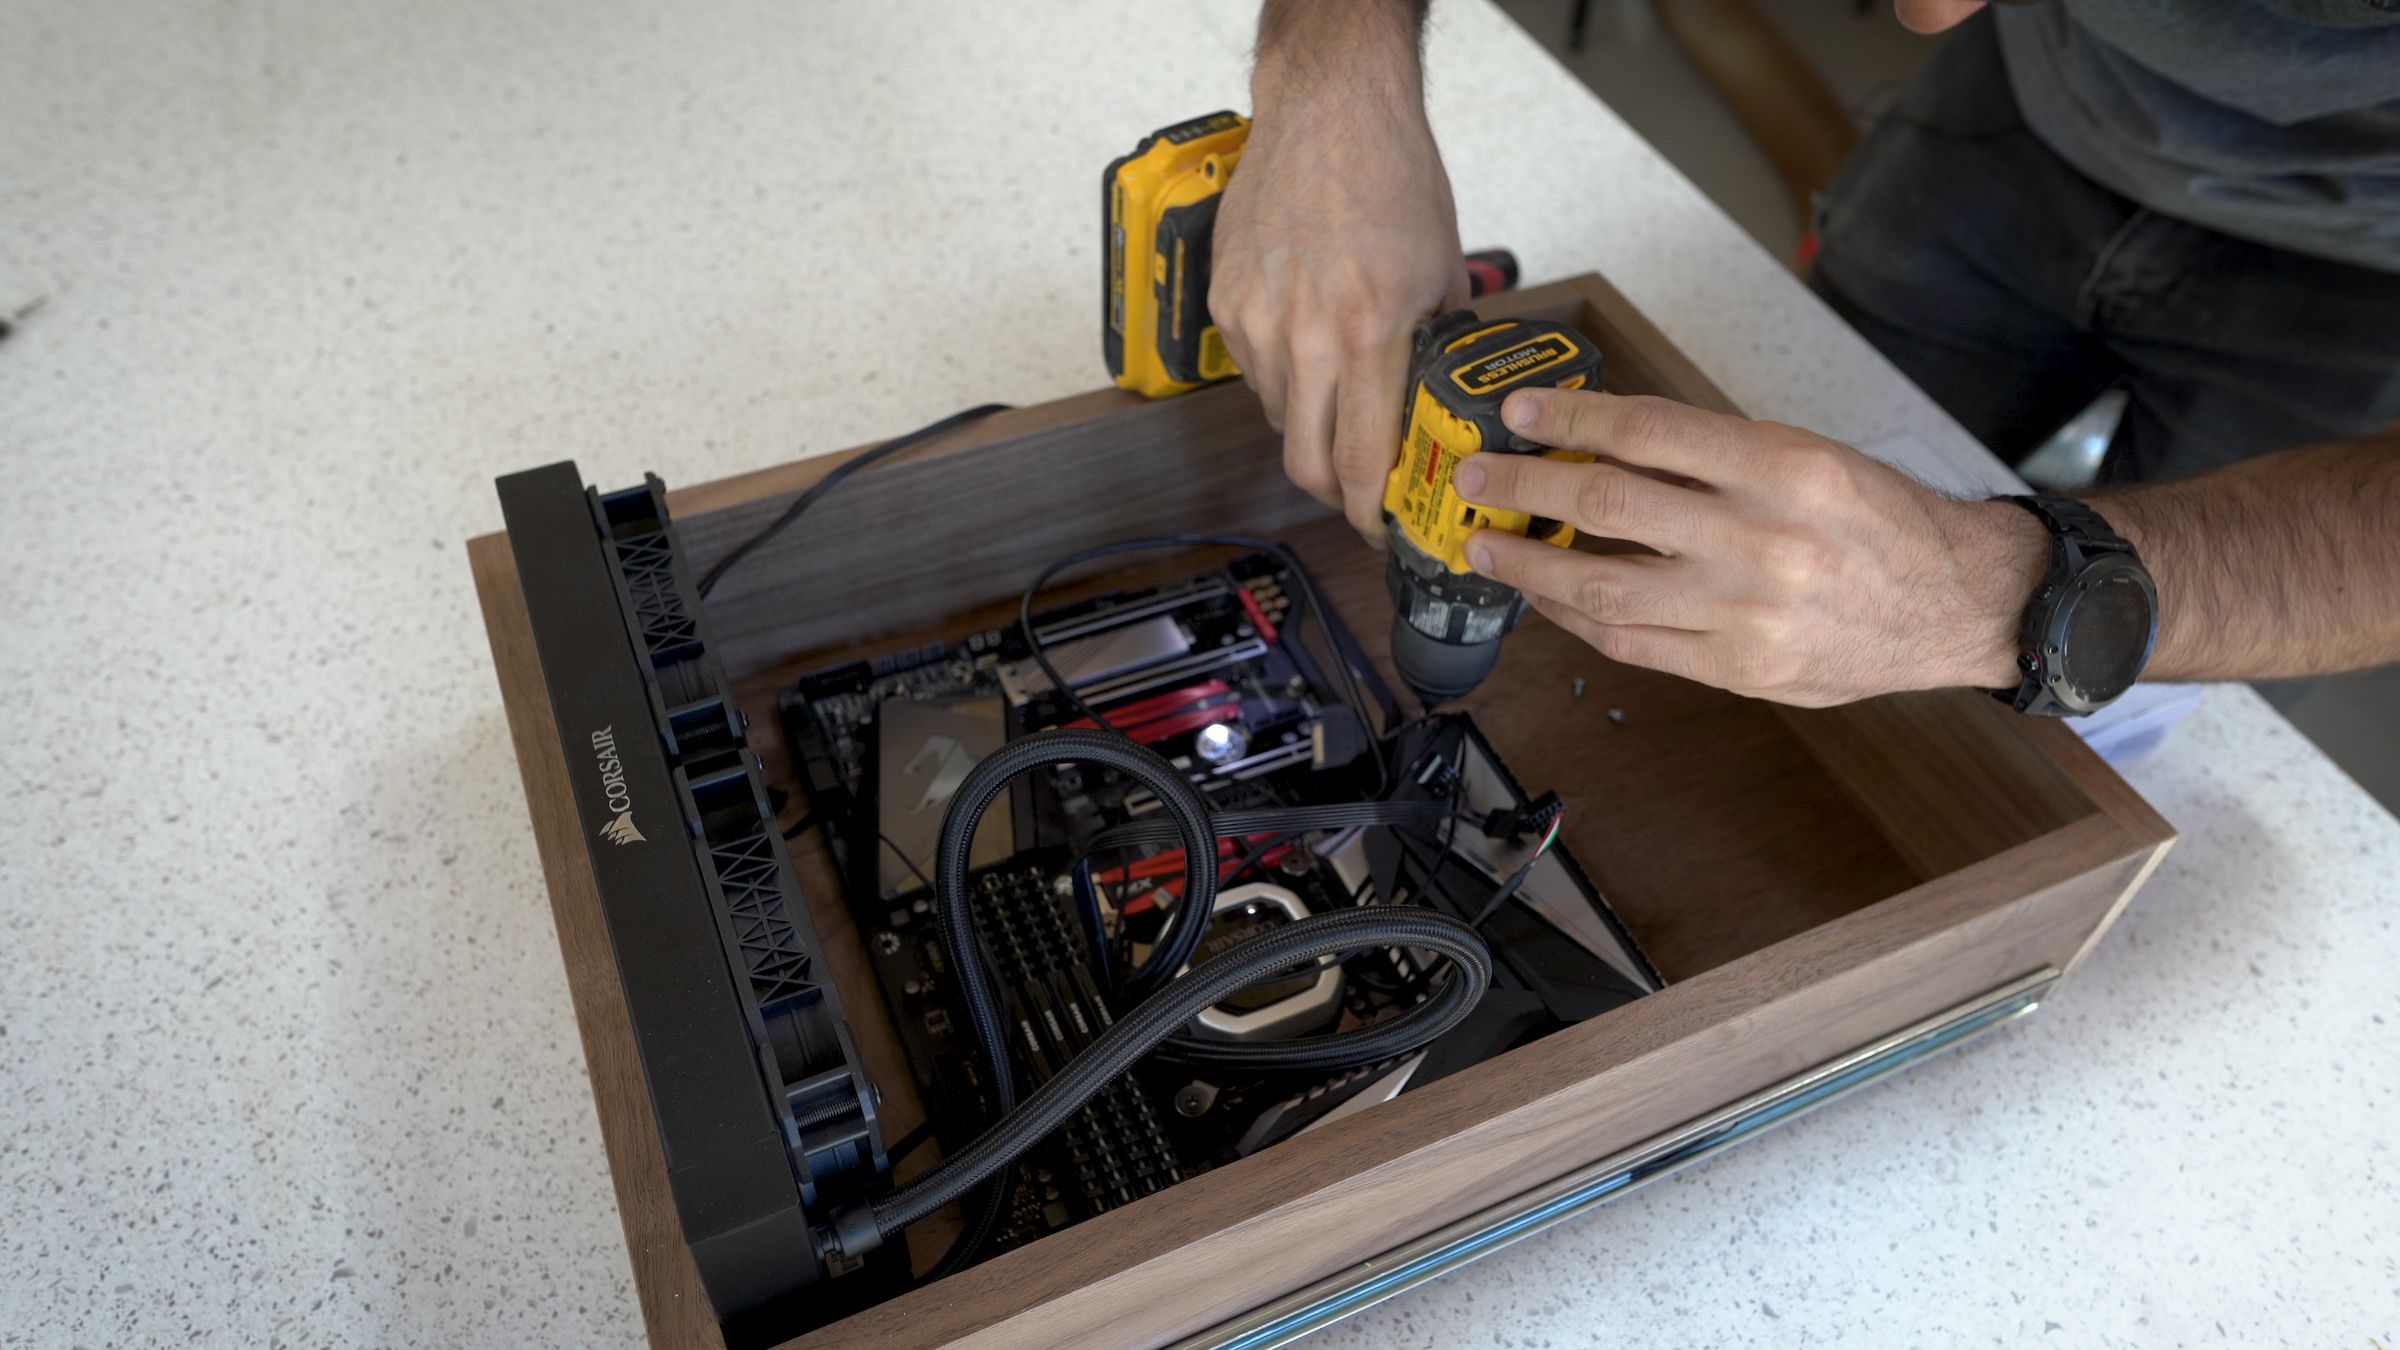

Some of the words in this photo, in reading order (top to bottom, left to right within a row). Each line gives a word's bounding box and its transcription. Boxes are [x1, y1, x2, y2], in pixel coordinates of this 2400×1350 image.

[1477, 348, 1557, 384] BRUSHLESS
[1485, 347, 1537, 371] MOTOR
[591, 724, 631, 813] CORSAIR
